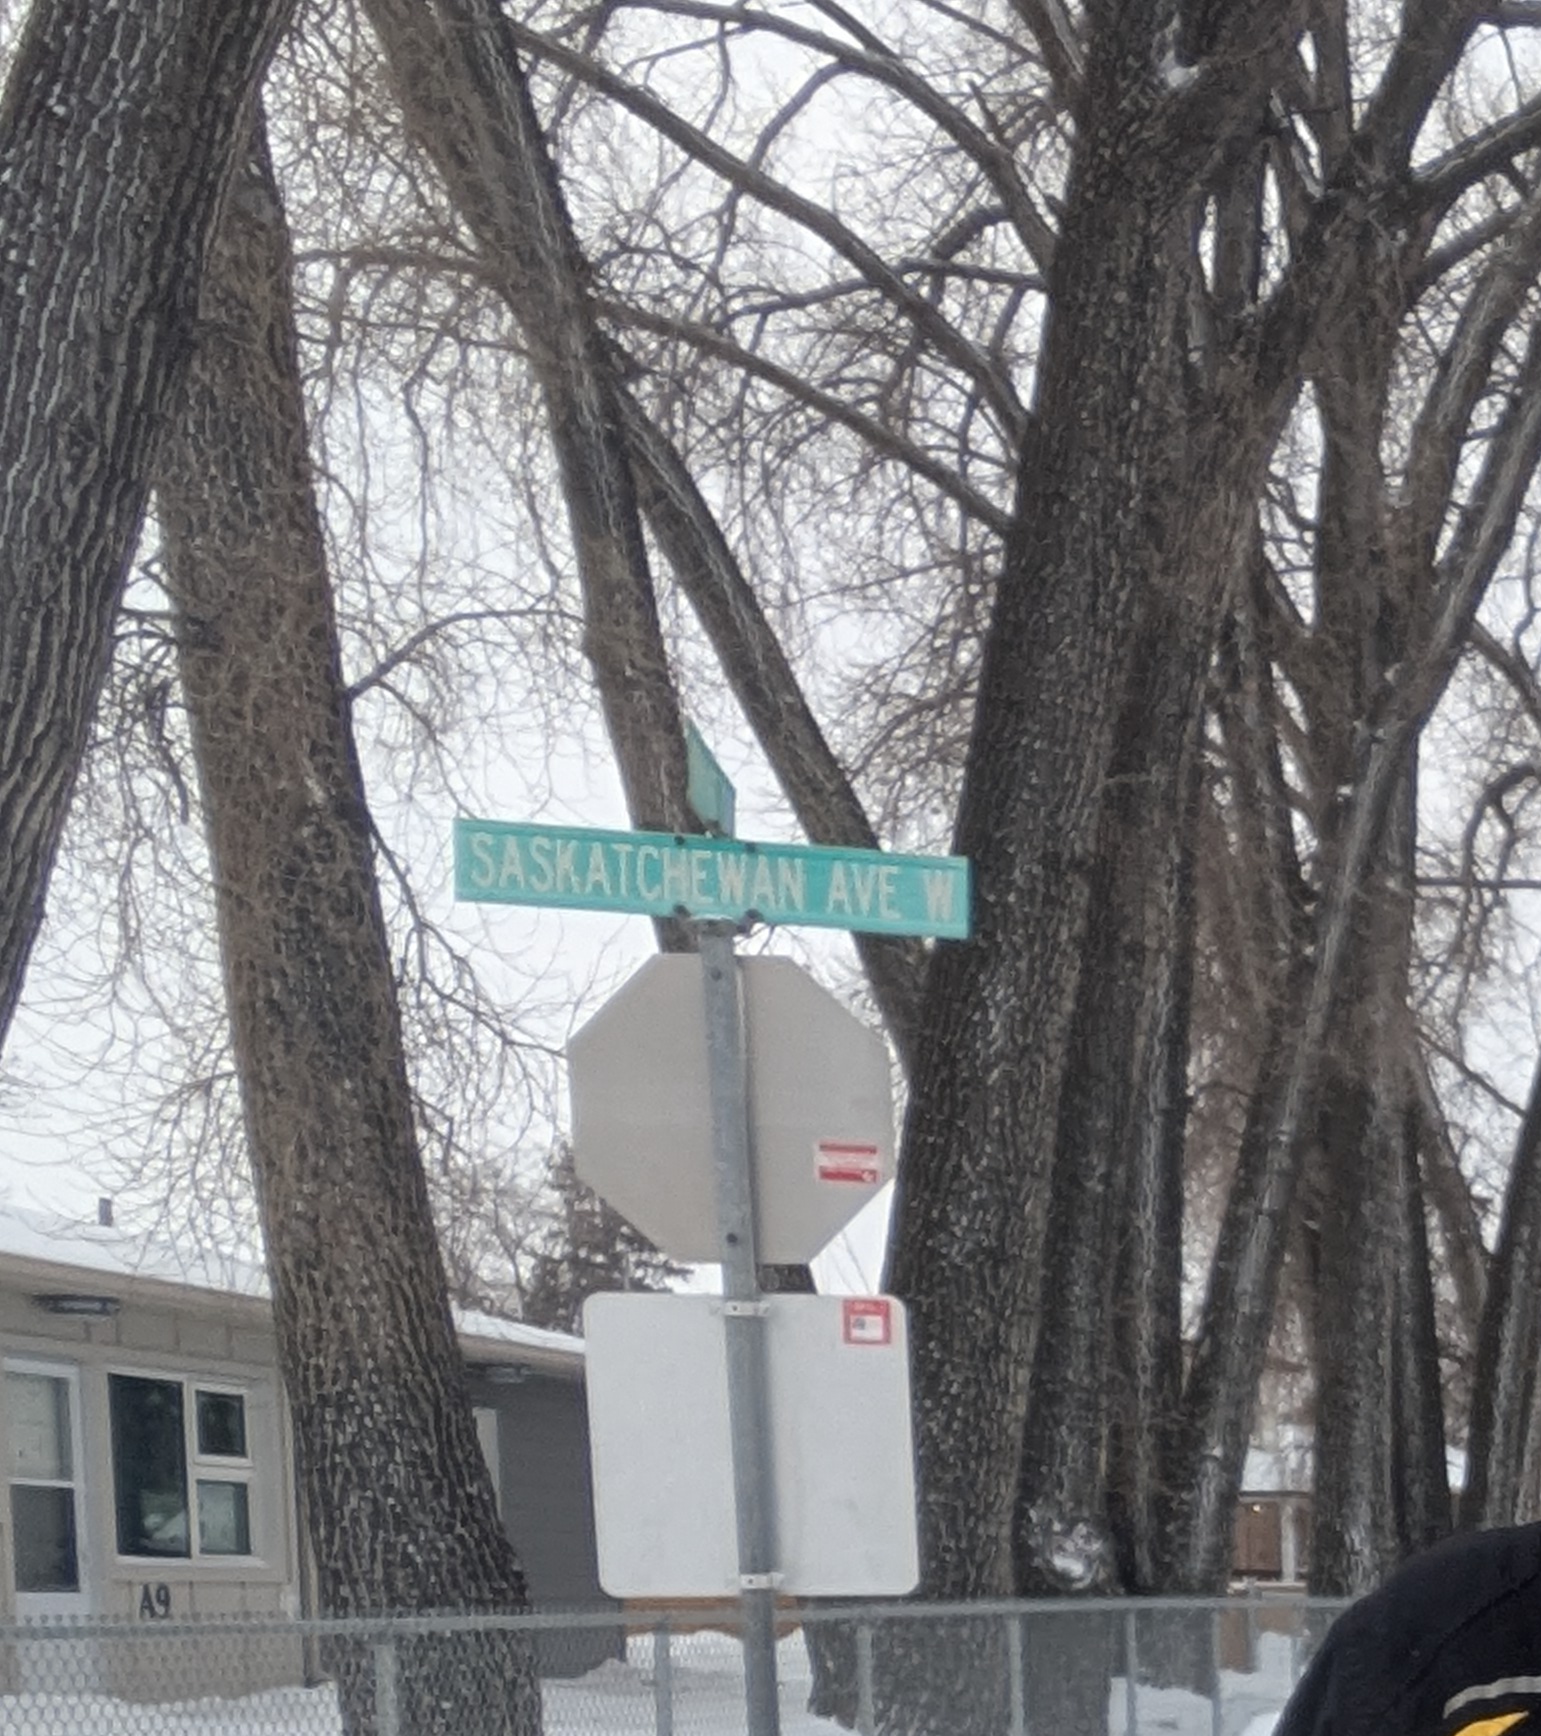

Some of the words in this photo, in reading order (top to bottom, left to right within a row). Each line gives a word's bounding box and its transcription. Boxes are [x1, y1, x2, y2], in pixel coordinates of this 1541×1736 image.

[470, 832, 806, 911] SASKATCHEWAN
[826, 859, 901, 920] AVE
[922, 868, 955, 921] W
[139, 1582, 172, 1619] A9
